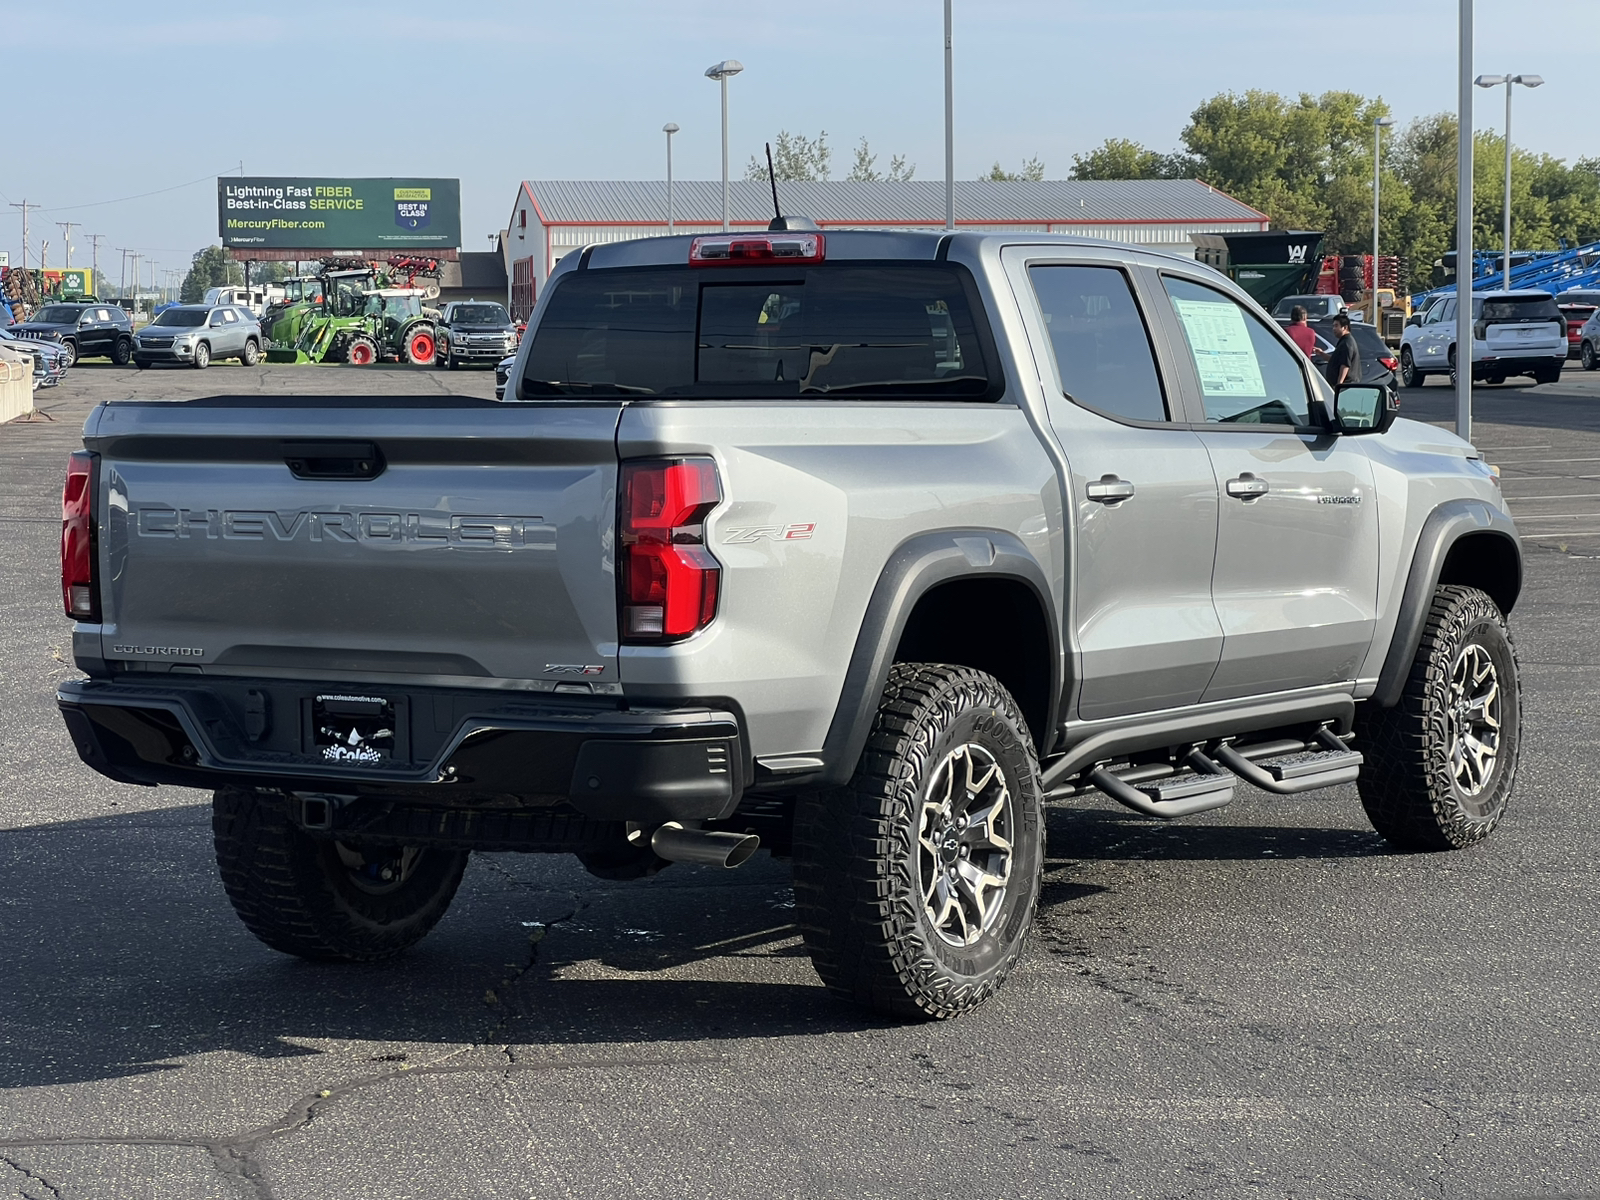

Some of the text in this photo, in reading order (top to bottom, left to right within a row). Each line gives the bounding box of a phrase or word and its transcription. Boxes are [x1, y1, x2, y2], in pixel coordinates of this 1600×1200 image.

[226, 185, 352, 199] Lightning Fast FIBER
[227, 198, 364, 210] Best-in-Class SERVICE
[397, 203, 428, 211] BEST IN
[227, 219, 325, 230] MercuryFiber.com
[137, 507, 557, 551] CHEVROLET
[721, 522, 817, 545] ZR2
[113, 644, 204, 657] COLORADO
[335, 746, 369, 761] Cole
